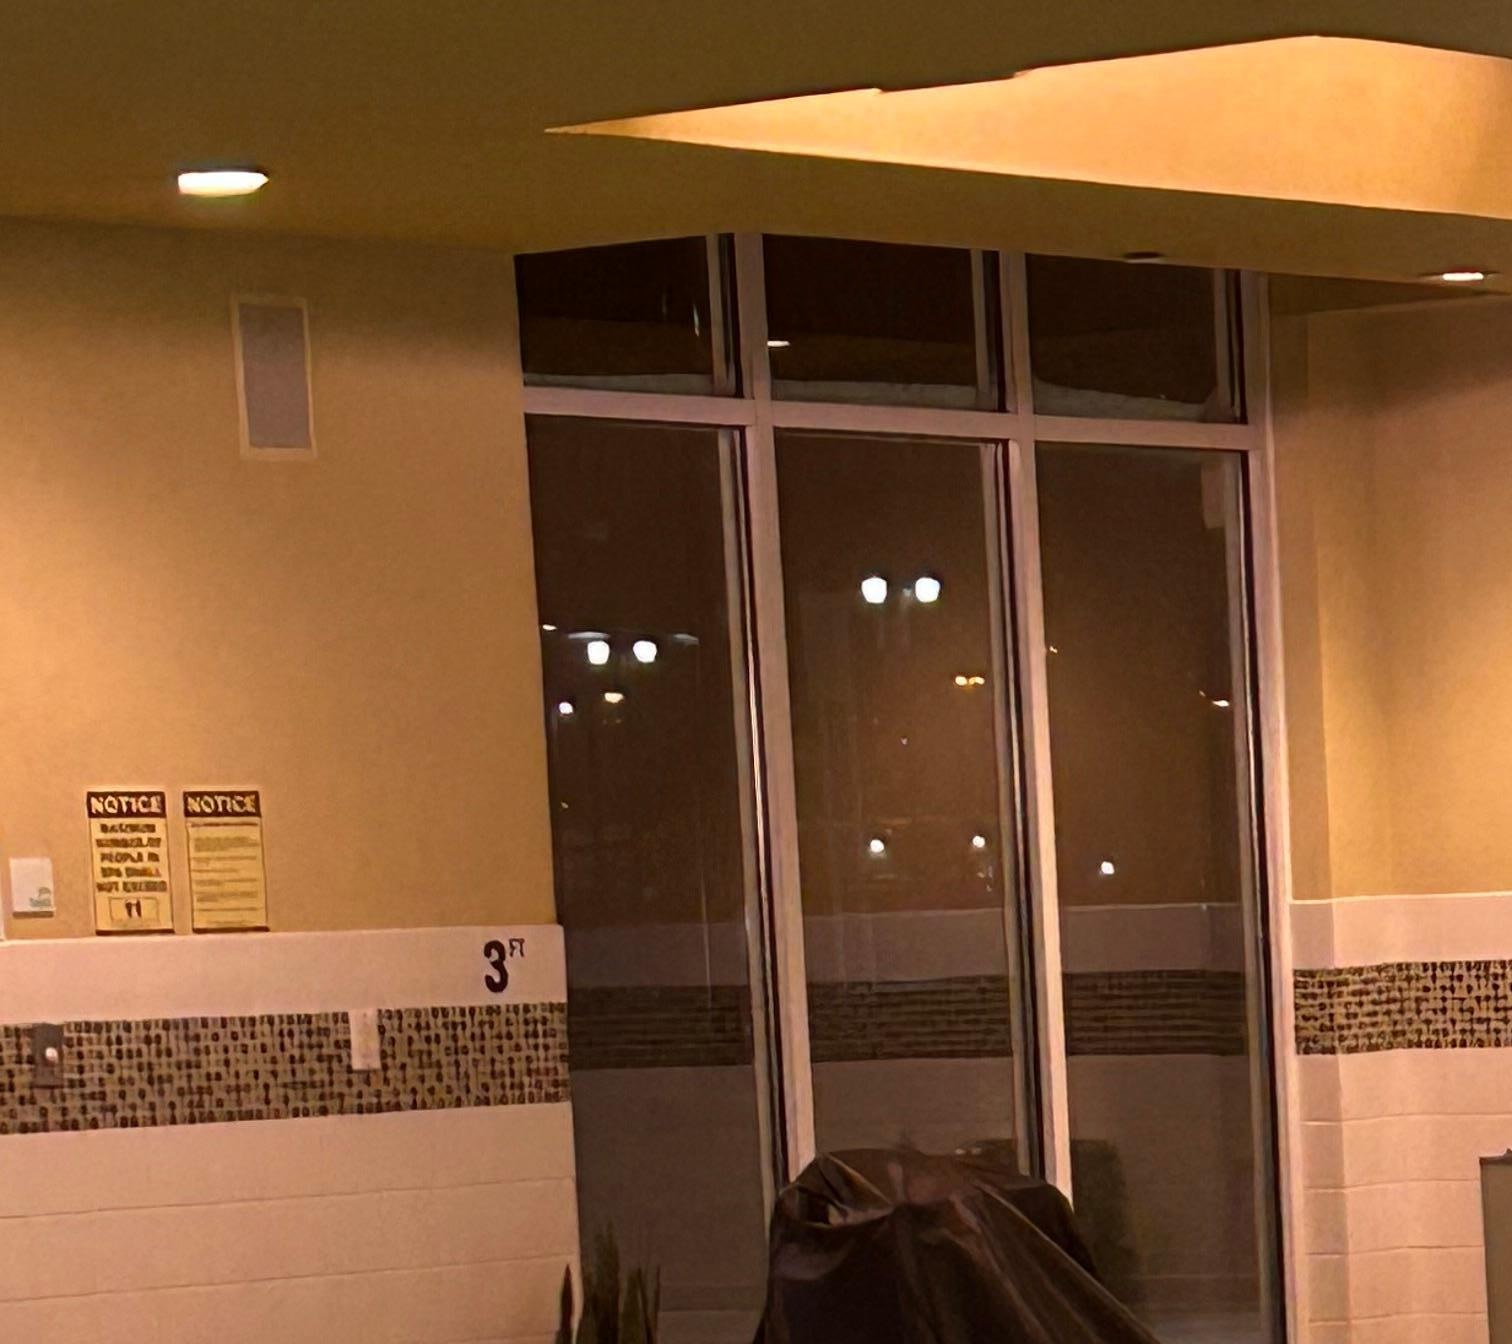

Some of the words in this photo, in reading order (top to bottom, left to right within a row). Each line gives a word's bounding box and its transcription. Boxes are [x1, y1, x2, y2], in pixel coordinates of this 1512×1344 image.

[90, 795, 161, 814] NOTICE
[187, 794, 256, 813] NOTICE
[483, 940, 509, 993] 3
[509, 938, 525, 957] FT
